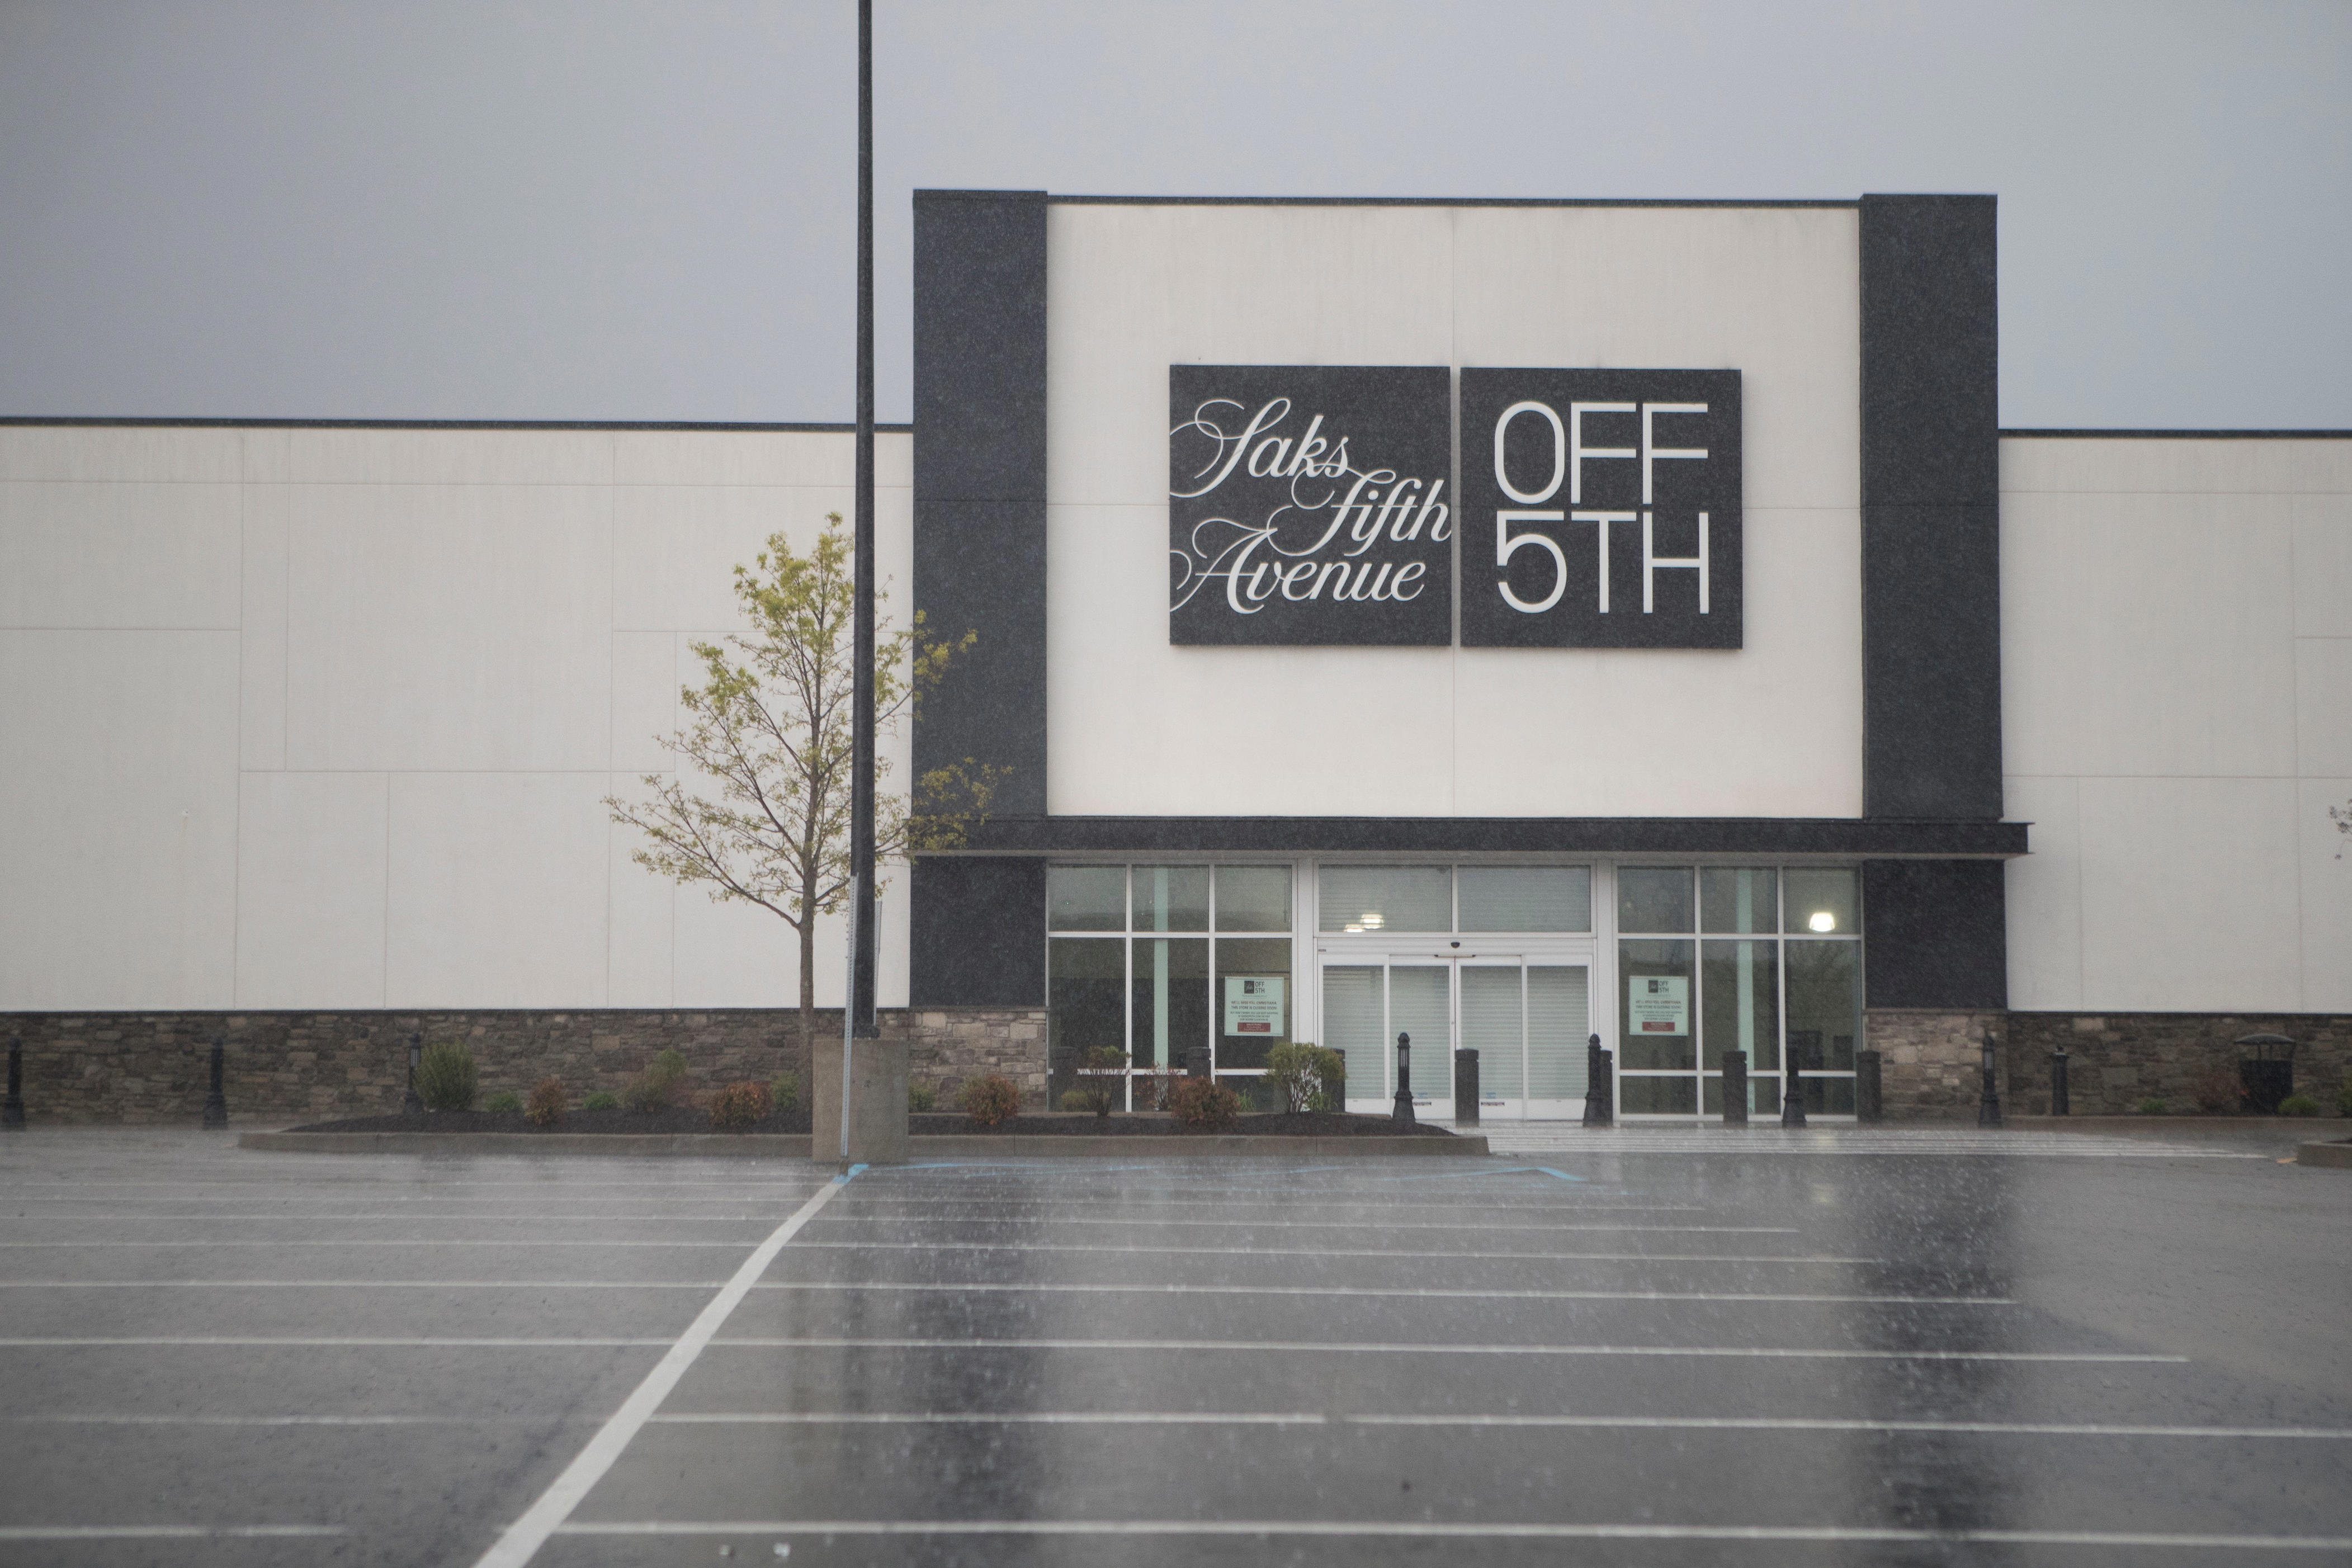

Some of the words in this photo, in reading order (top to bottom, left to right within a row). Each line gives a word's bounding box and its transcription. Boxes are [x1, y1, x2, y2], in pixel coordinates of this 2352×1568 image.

[1169, 398, 1349, 498] Saks
[1494, 401, 1708, 504] OFF
[1267, 463, 1452, 556] Fifth
[1169, 518, 1426, 614] Avenue
[1496, 511, 1709, 614] 5TH
